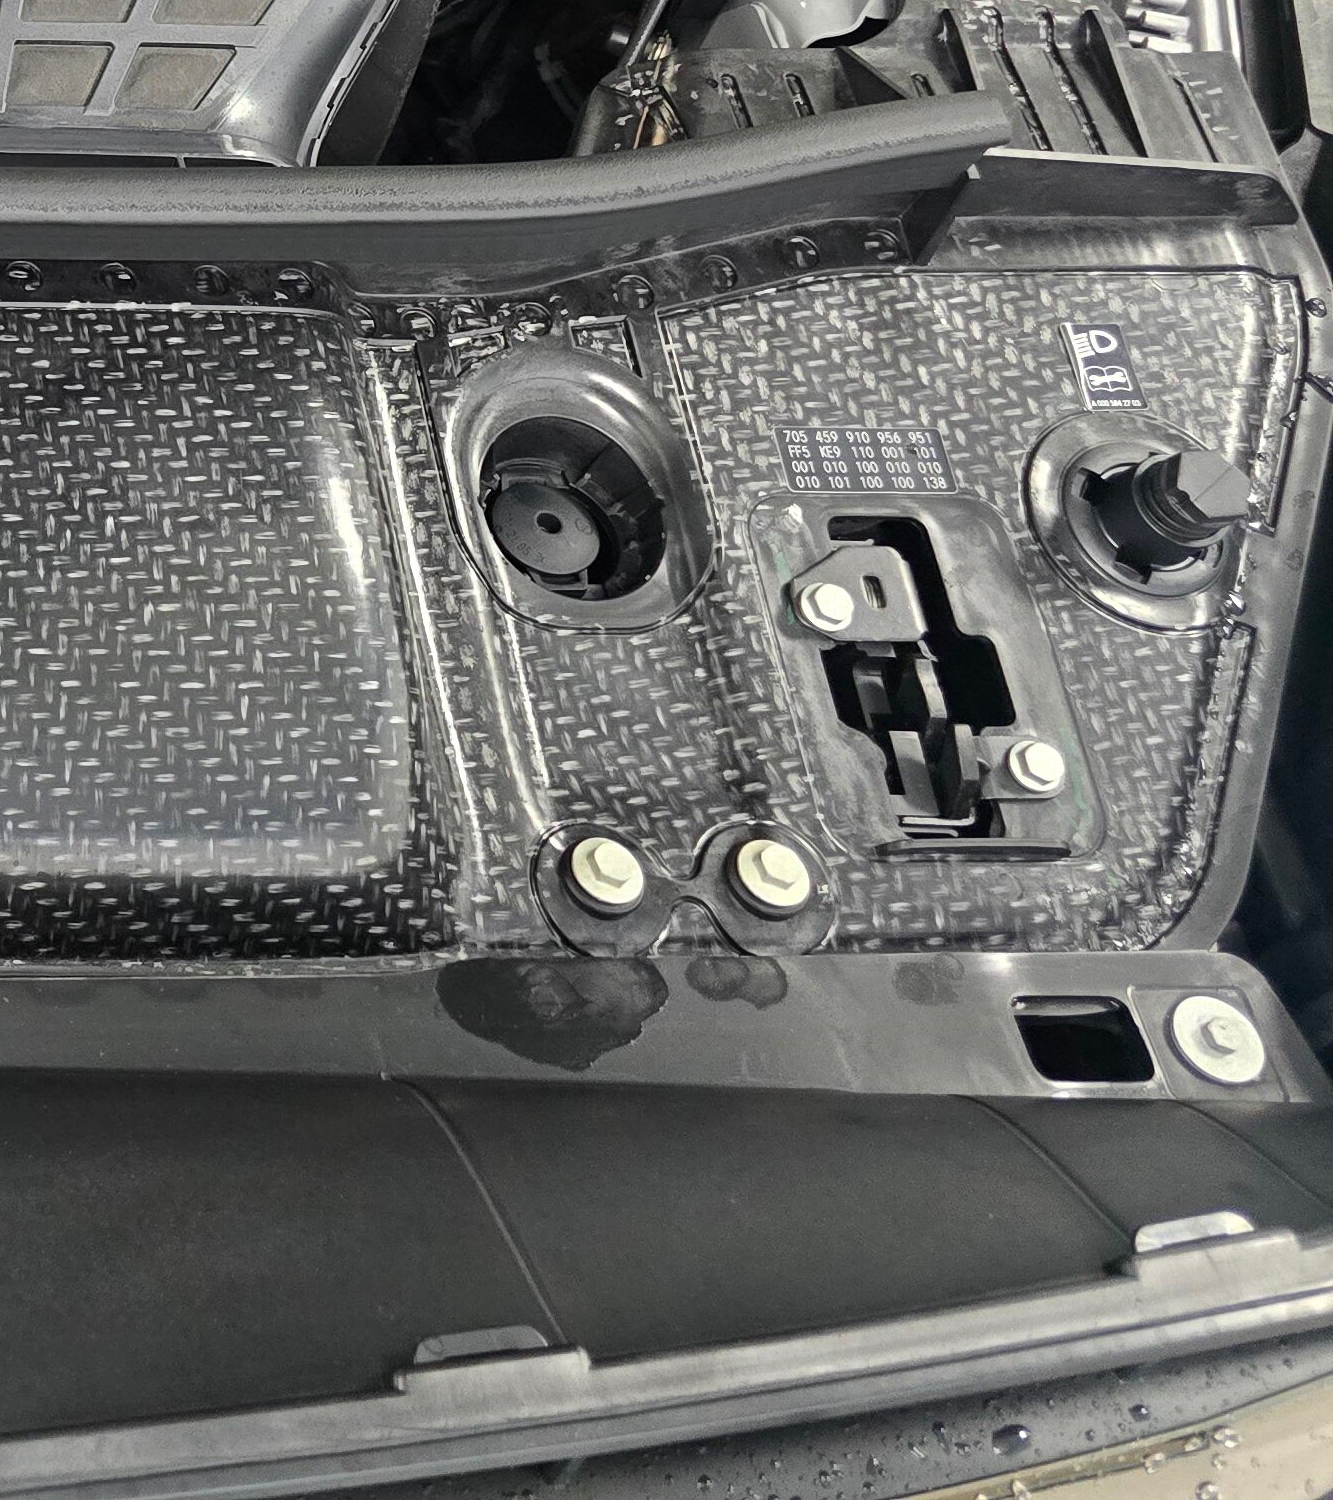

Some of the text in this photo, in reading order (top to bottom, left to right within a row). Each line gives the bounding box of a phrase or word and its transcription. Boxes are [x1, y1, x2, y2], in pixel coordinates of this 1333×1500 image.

[783, 430, 932, 443] 705 459 910 956 951
[788, 445, 937, 458] FF5 KE9 110 001 101
[792, 461, 942, 473] 001 010 100 010 010
[796, 476, 947, 489] 010 101 100 100 138
